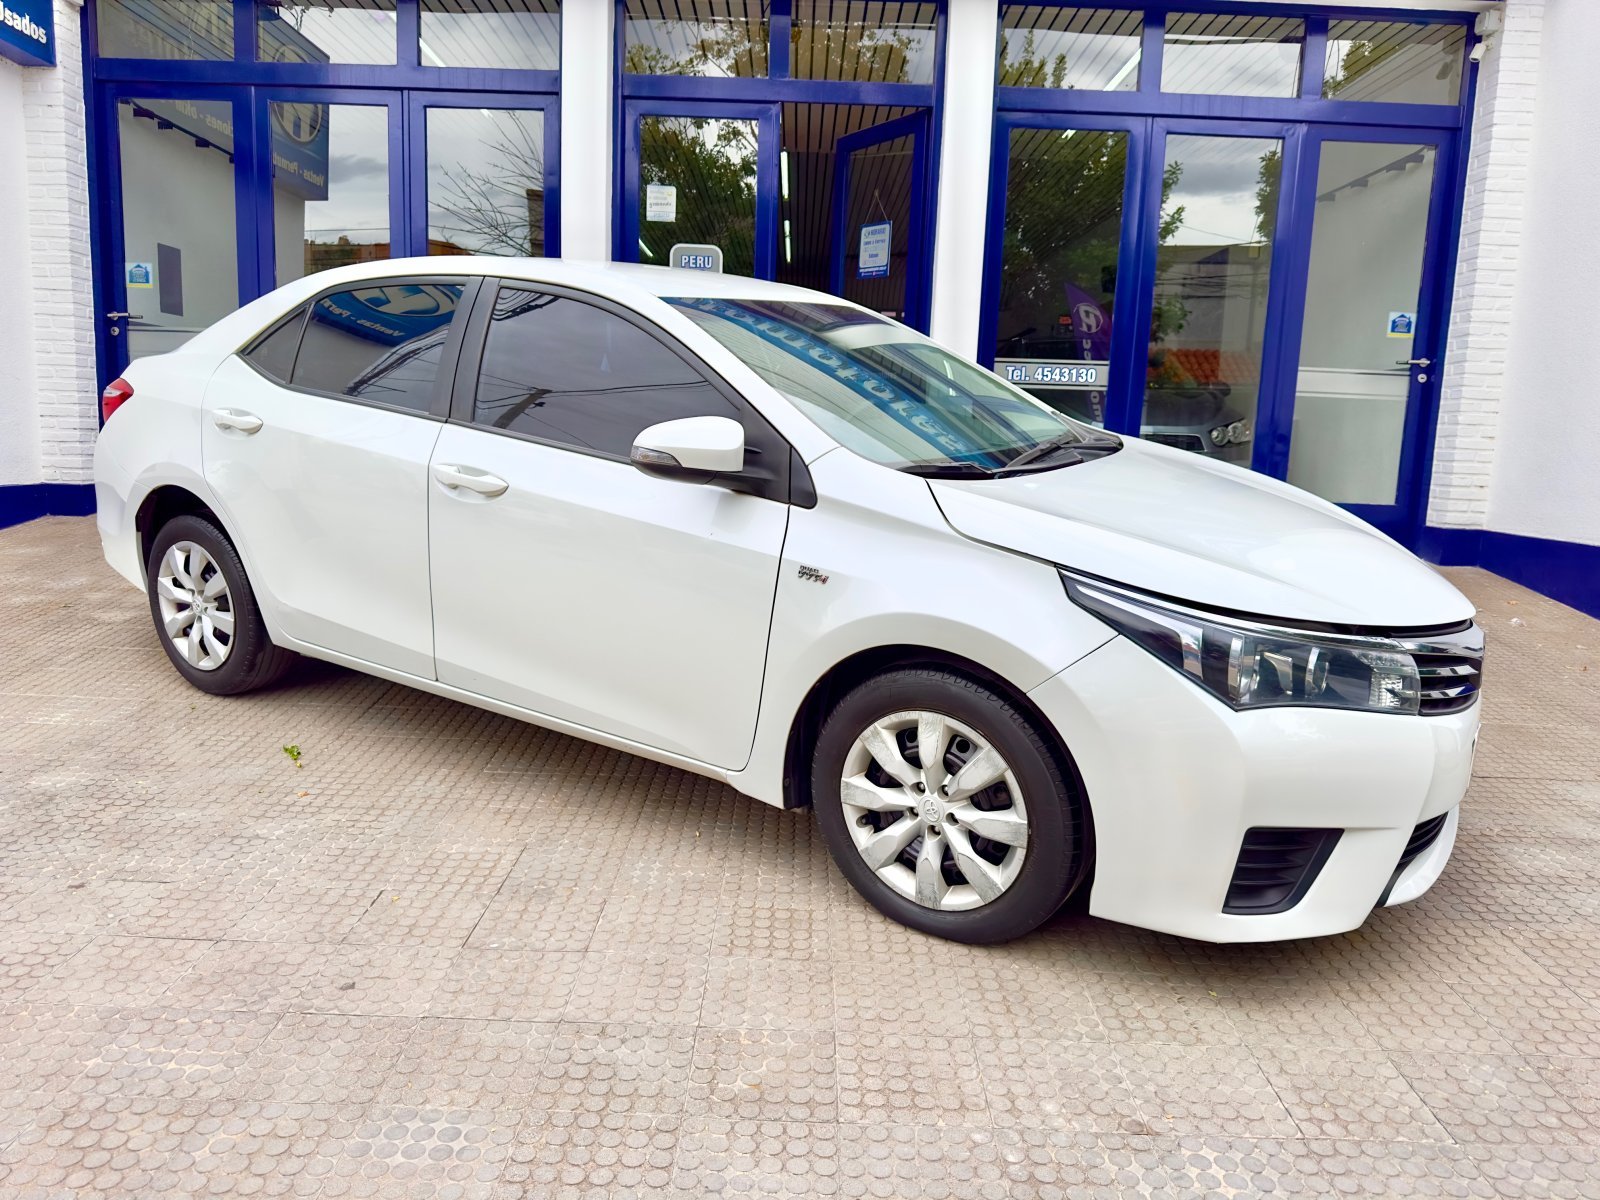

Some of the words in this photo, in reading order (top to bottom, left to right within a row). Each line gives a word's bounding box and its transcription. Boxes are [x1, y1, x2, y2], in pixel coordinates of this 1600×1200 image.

[681, 254, 713, 269] PERU
[1006, 366, 1029, 381] Tel.
[1034, 367, 1097, 383] 4543130
